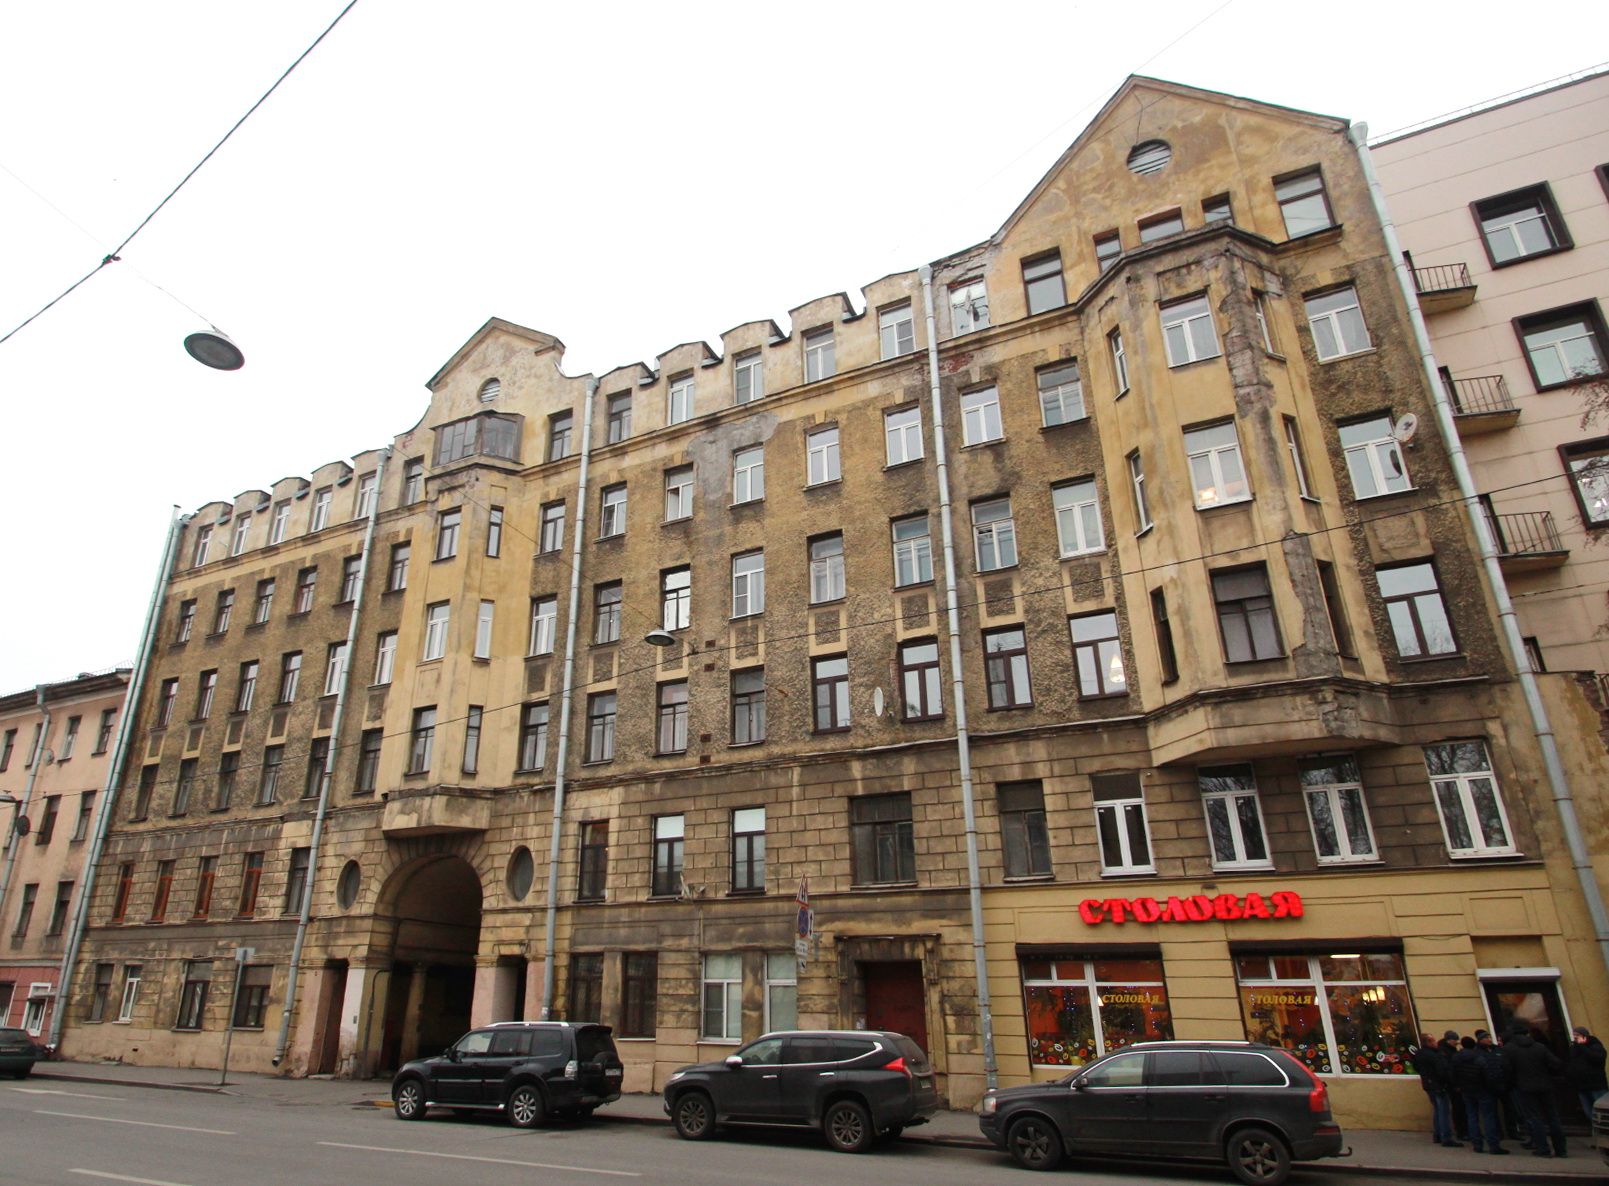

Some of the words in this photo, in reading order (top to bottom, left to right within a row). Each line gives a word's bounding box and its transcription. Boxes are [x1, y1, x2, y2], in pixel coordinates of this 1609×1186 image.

[1078, 891, 1304, 925] СТОЛОВАЯ
[1102, 994, 1160, 1004] СТОЛОВАЯ
[1250, 995, 1312, 1005] ТОЛОВАЯ
